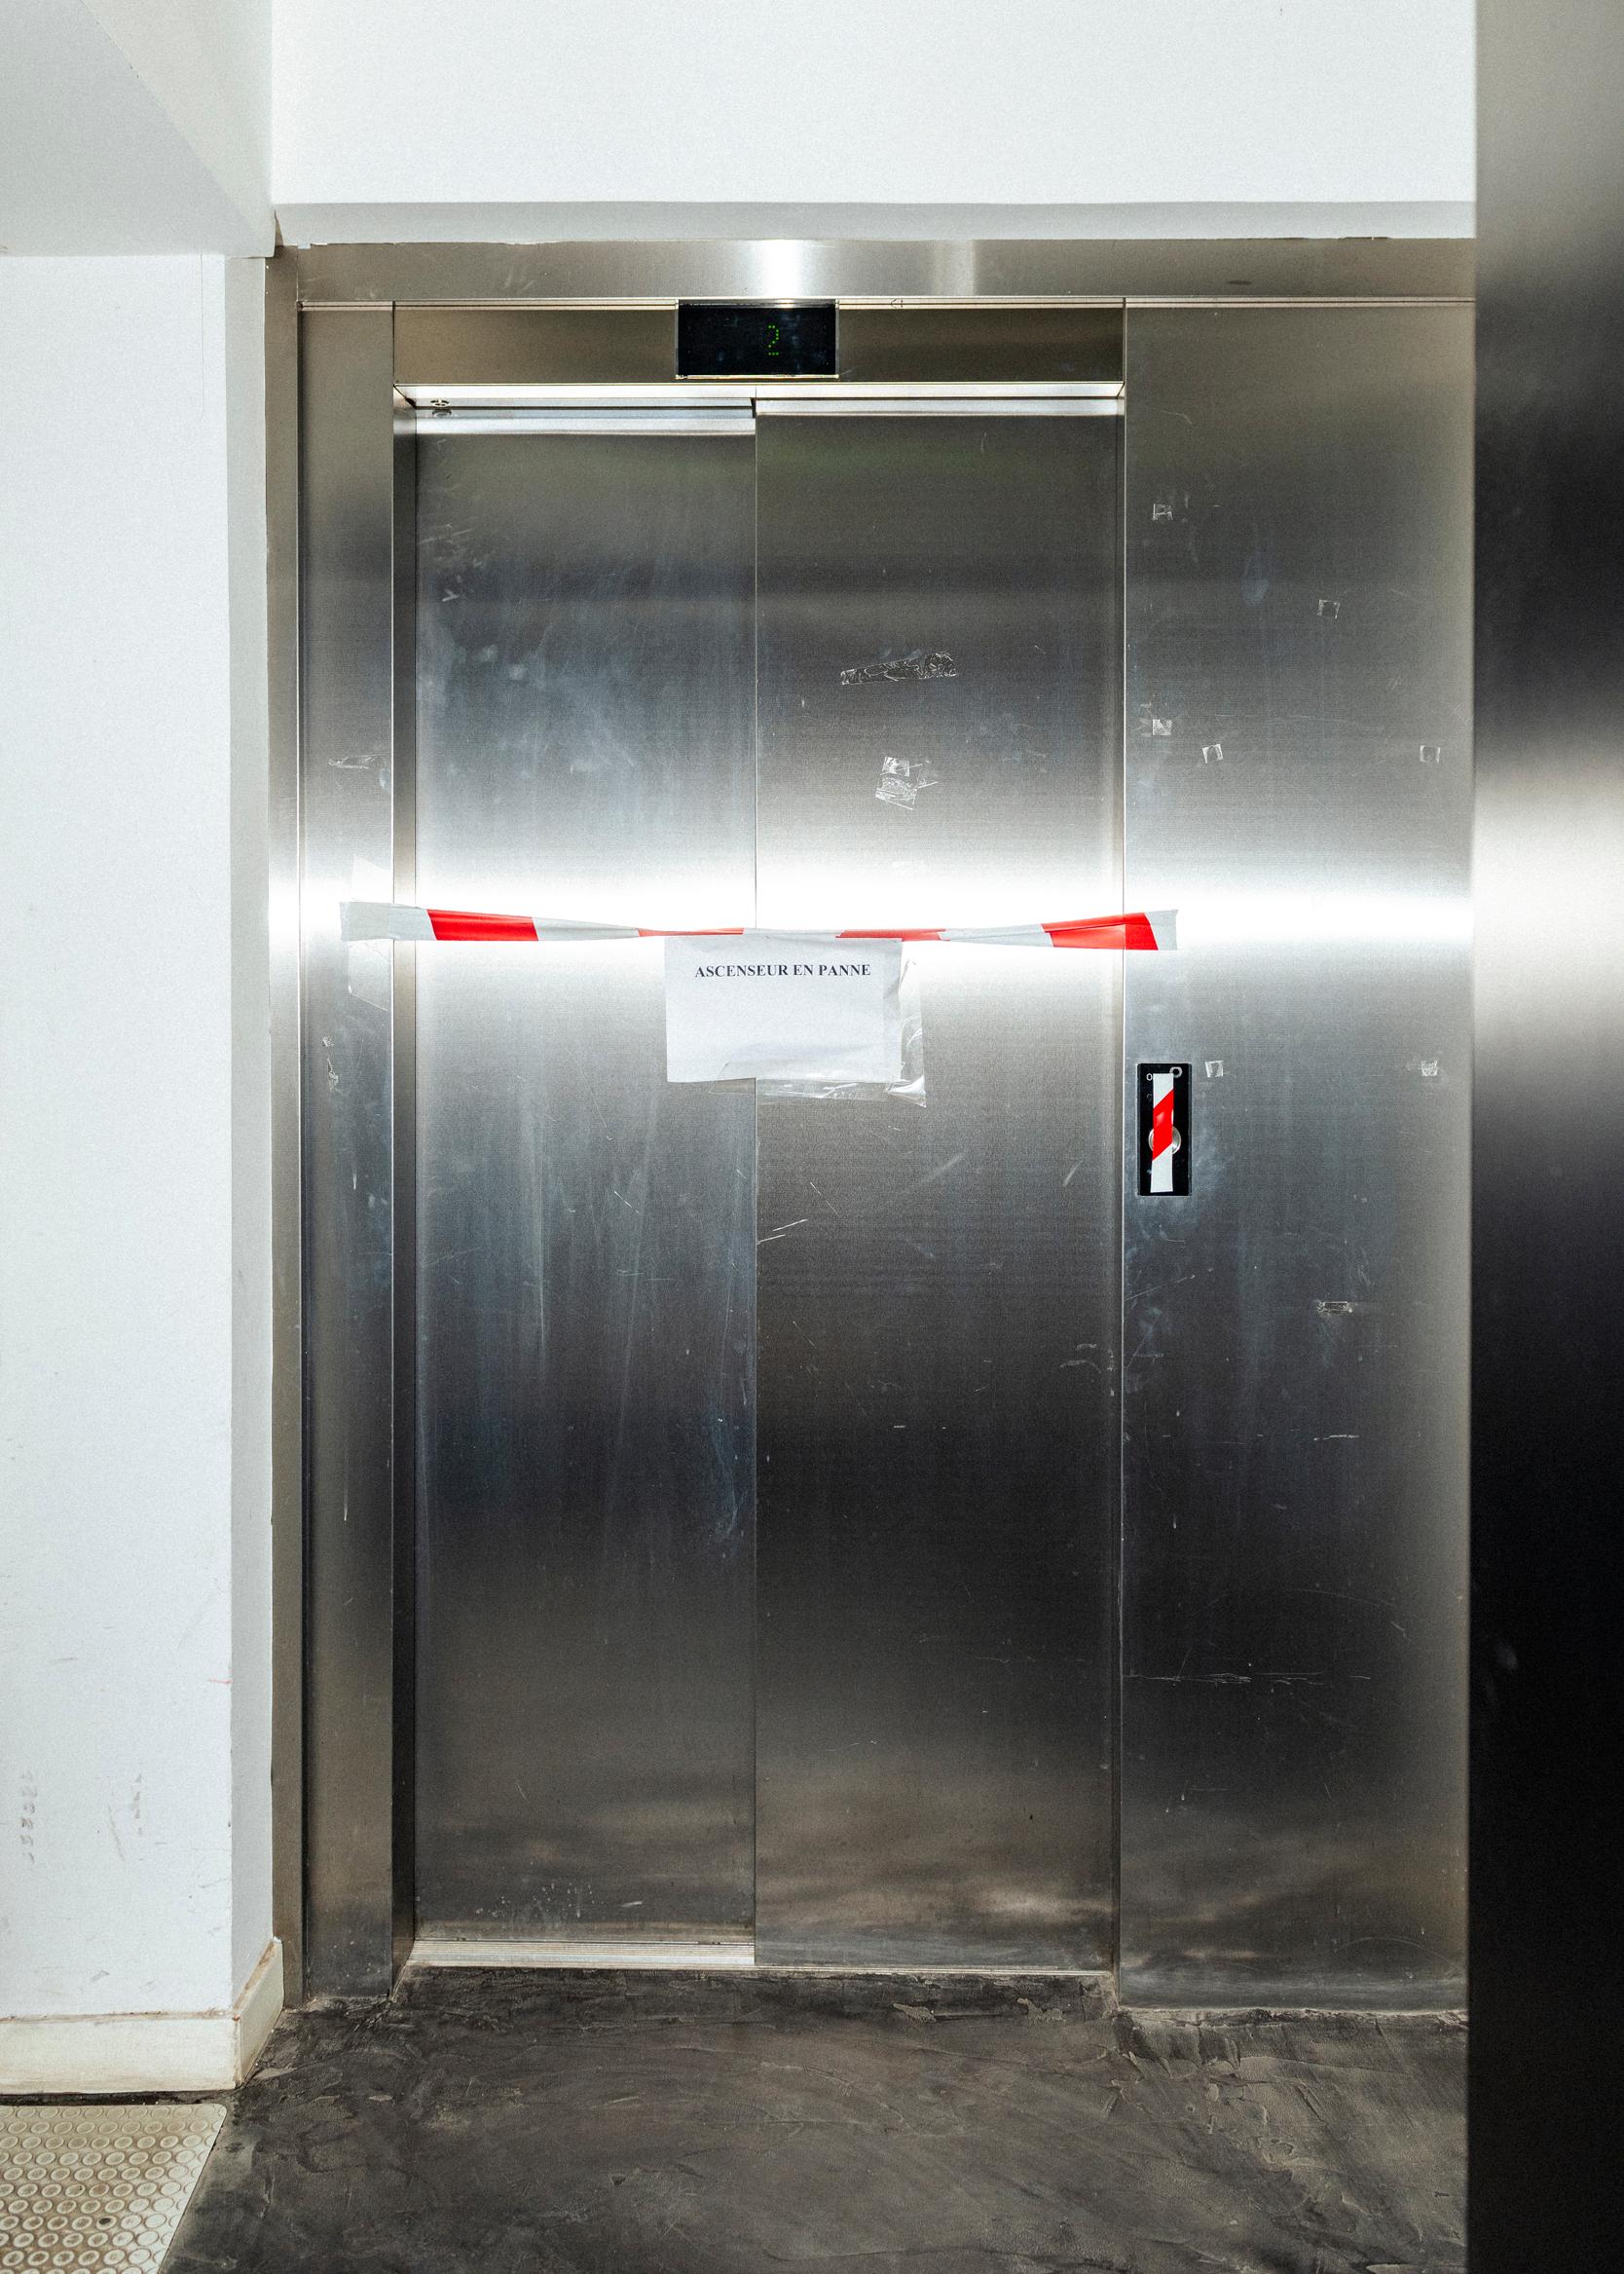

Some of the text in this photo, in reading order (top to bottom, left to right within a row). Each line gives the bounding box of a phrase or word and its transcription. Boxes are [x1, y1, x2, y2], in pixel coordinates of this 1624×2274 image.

[767, 324, 780, 356] 2
[694, 964, 871, 978] ASCENSEUR EN PANNE
